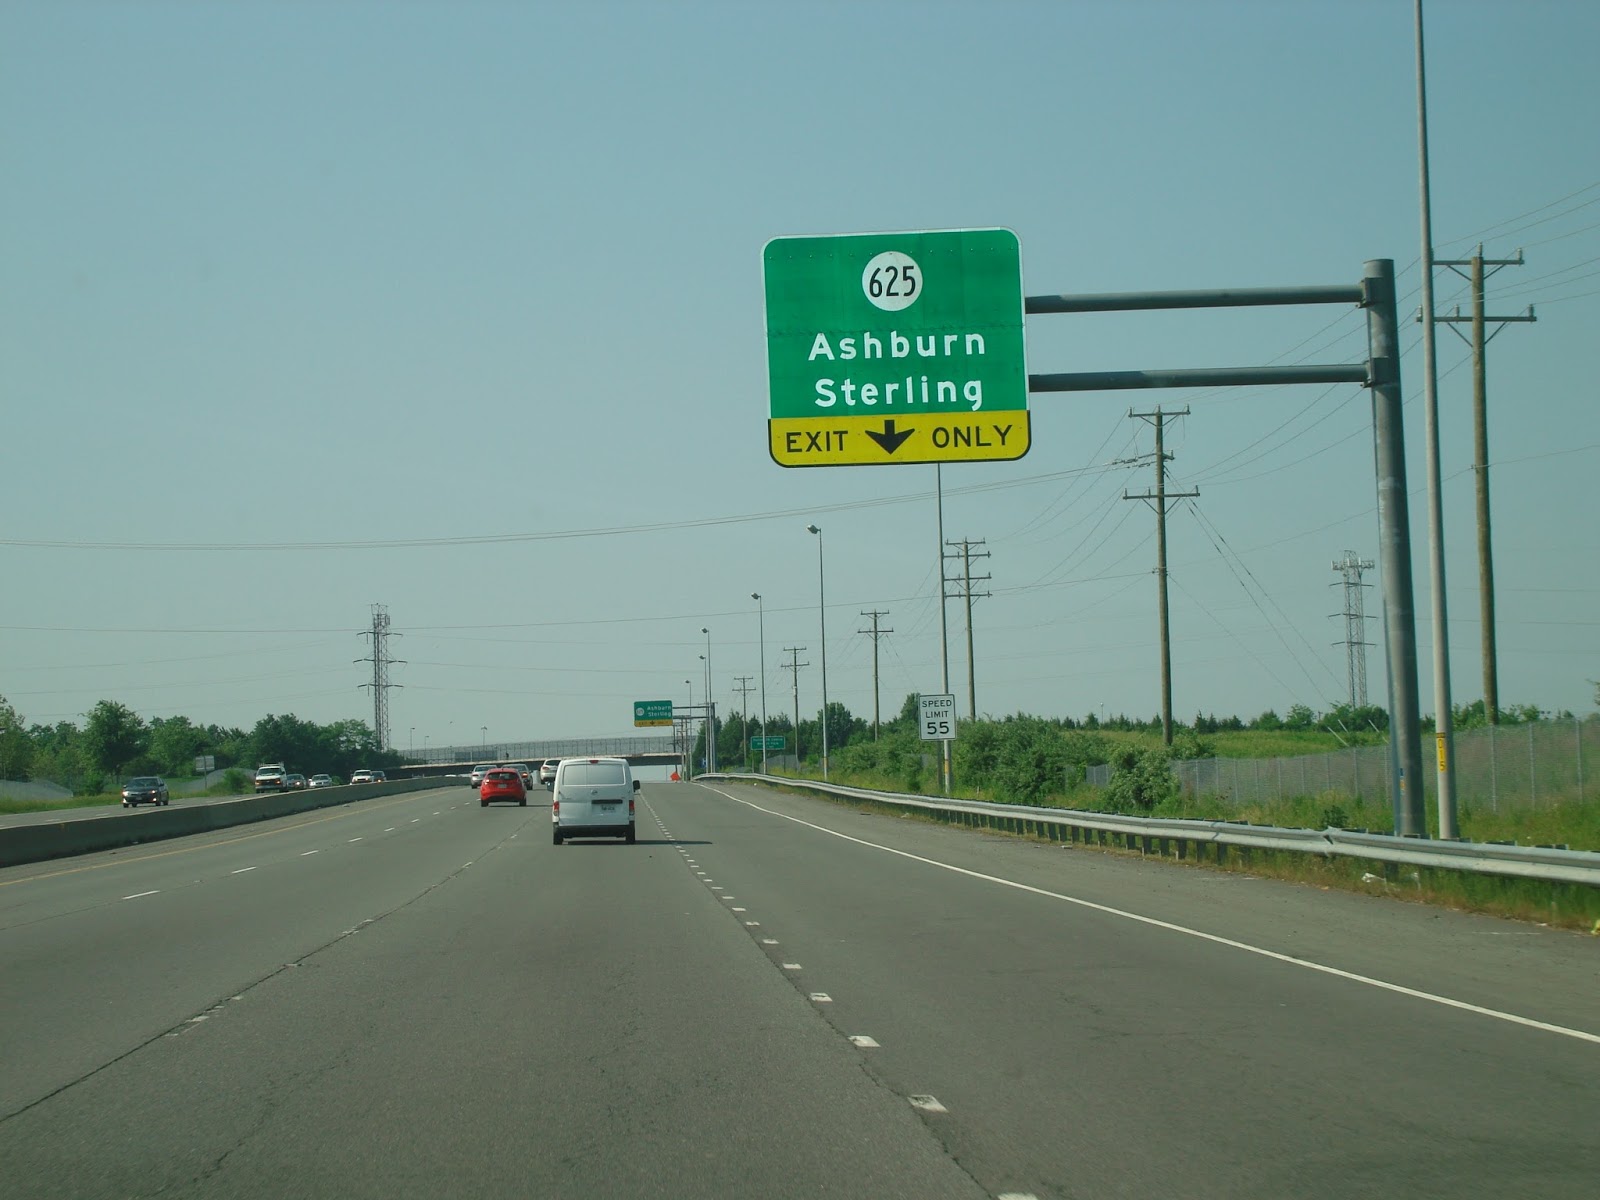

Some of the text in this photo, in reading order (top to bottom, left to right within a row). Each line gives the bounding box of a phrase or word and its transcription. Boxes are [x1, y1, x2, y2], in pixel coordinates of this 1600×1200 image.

[869, 265, 916, 298] 625
[808, 331, 986, 361] Ashburn
[814, 375, 983, 412] Sterling
[786, 424, 1013, 453] EXIT ONLY
[927, 721, 950, 735] 55
